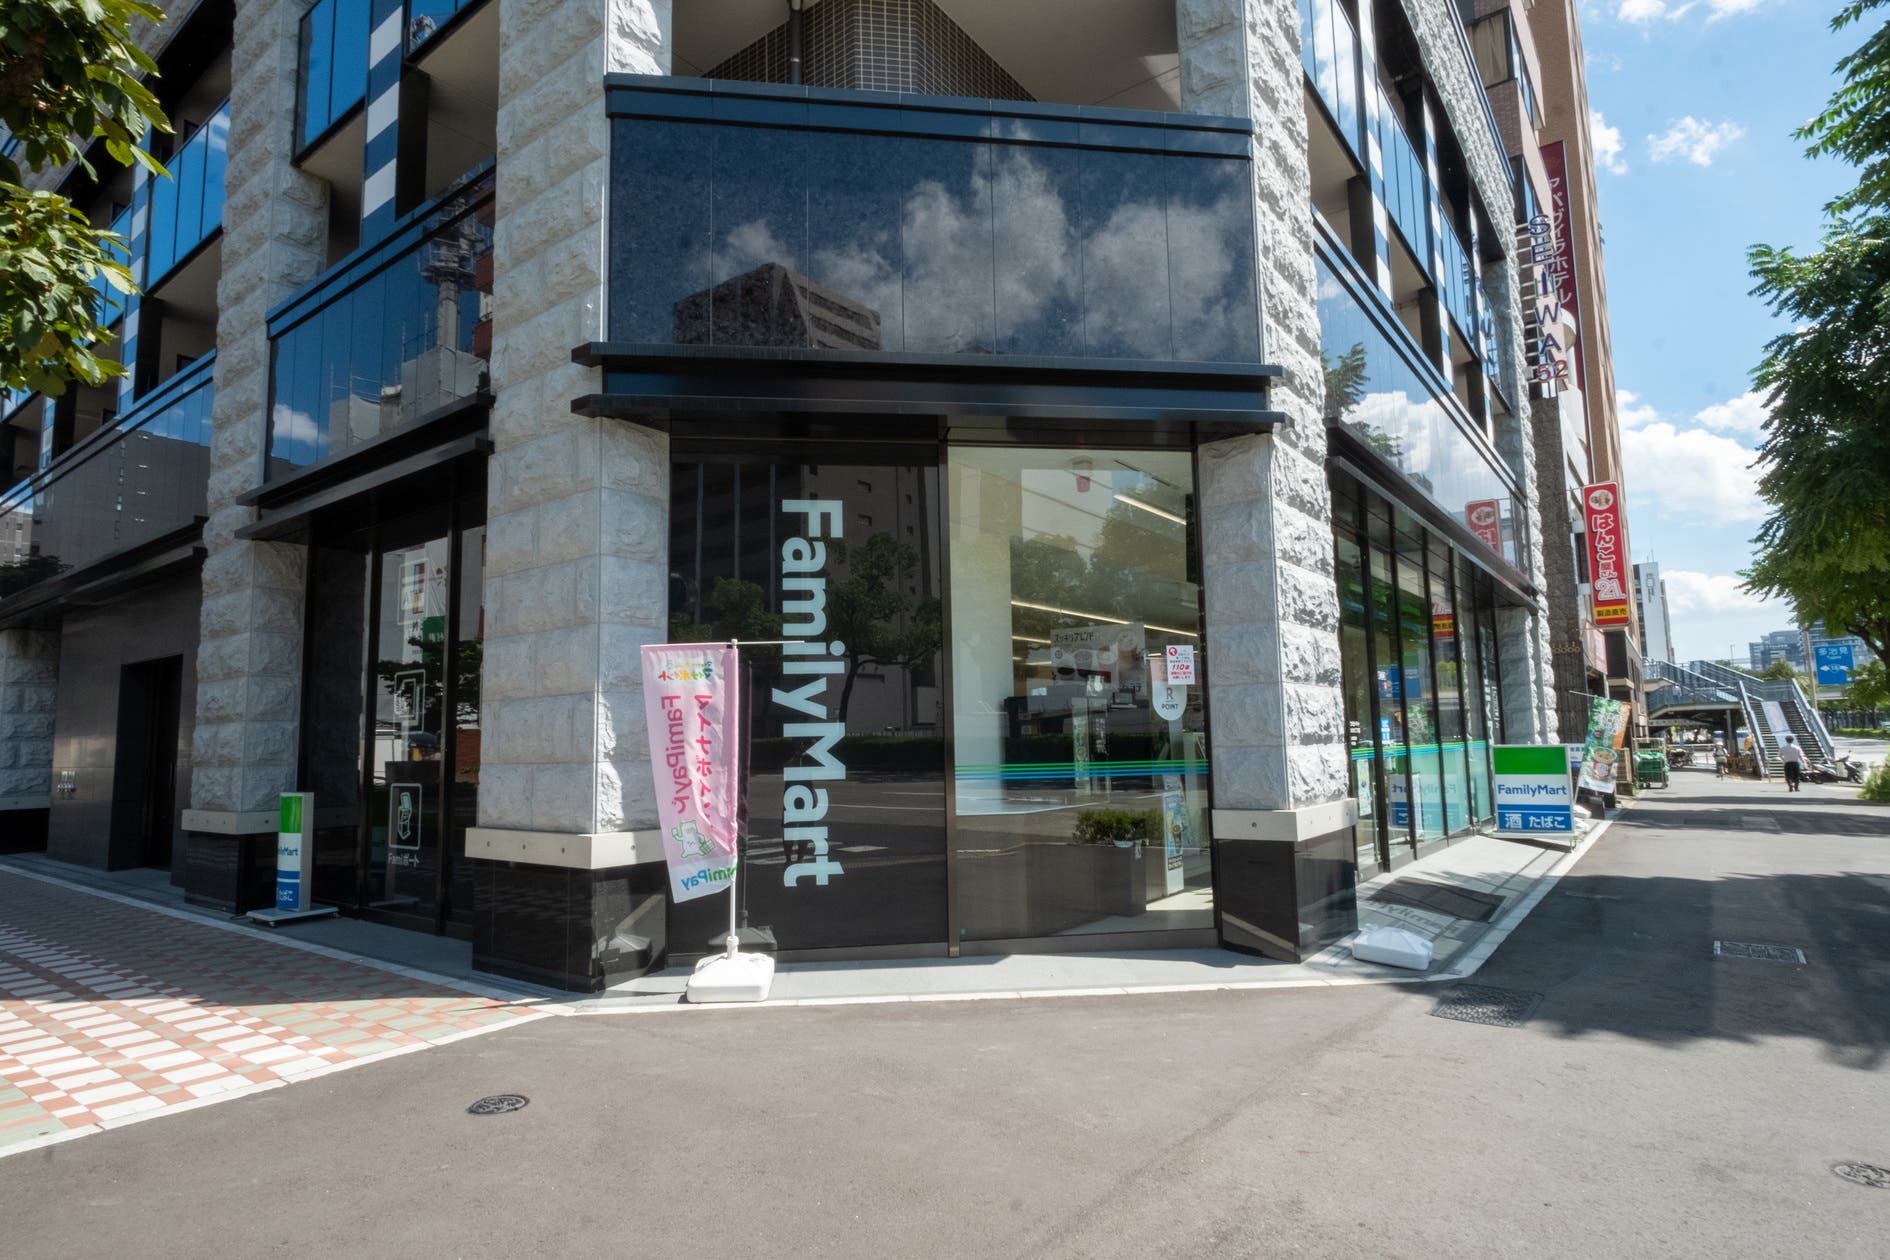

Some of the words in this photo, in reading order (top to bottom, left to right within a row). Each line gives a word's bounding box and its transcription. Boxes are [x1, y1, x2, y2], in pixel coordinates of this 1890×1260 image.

[1528, 213, 1562, 355] SEIWA
[1537, 358, 1568, 384] 52
[1818, 646, 1849, 656] 多治見
[772, 499, 846, 888] FamilyMart
[1166, 687, 1174, 700] R
[1497, 783, 1567, 798] FamilyMart
[1505, 813, 1522, 829] 酒
[1529, 815, 1566, 829] たばこ
